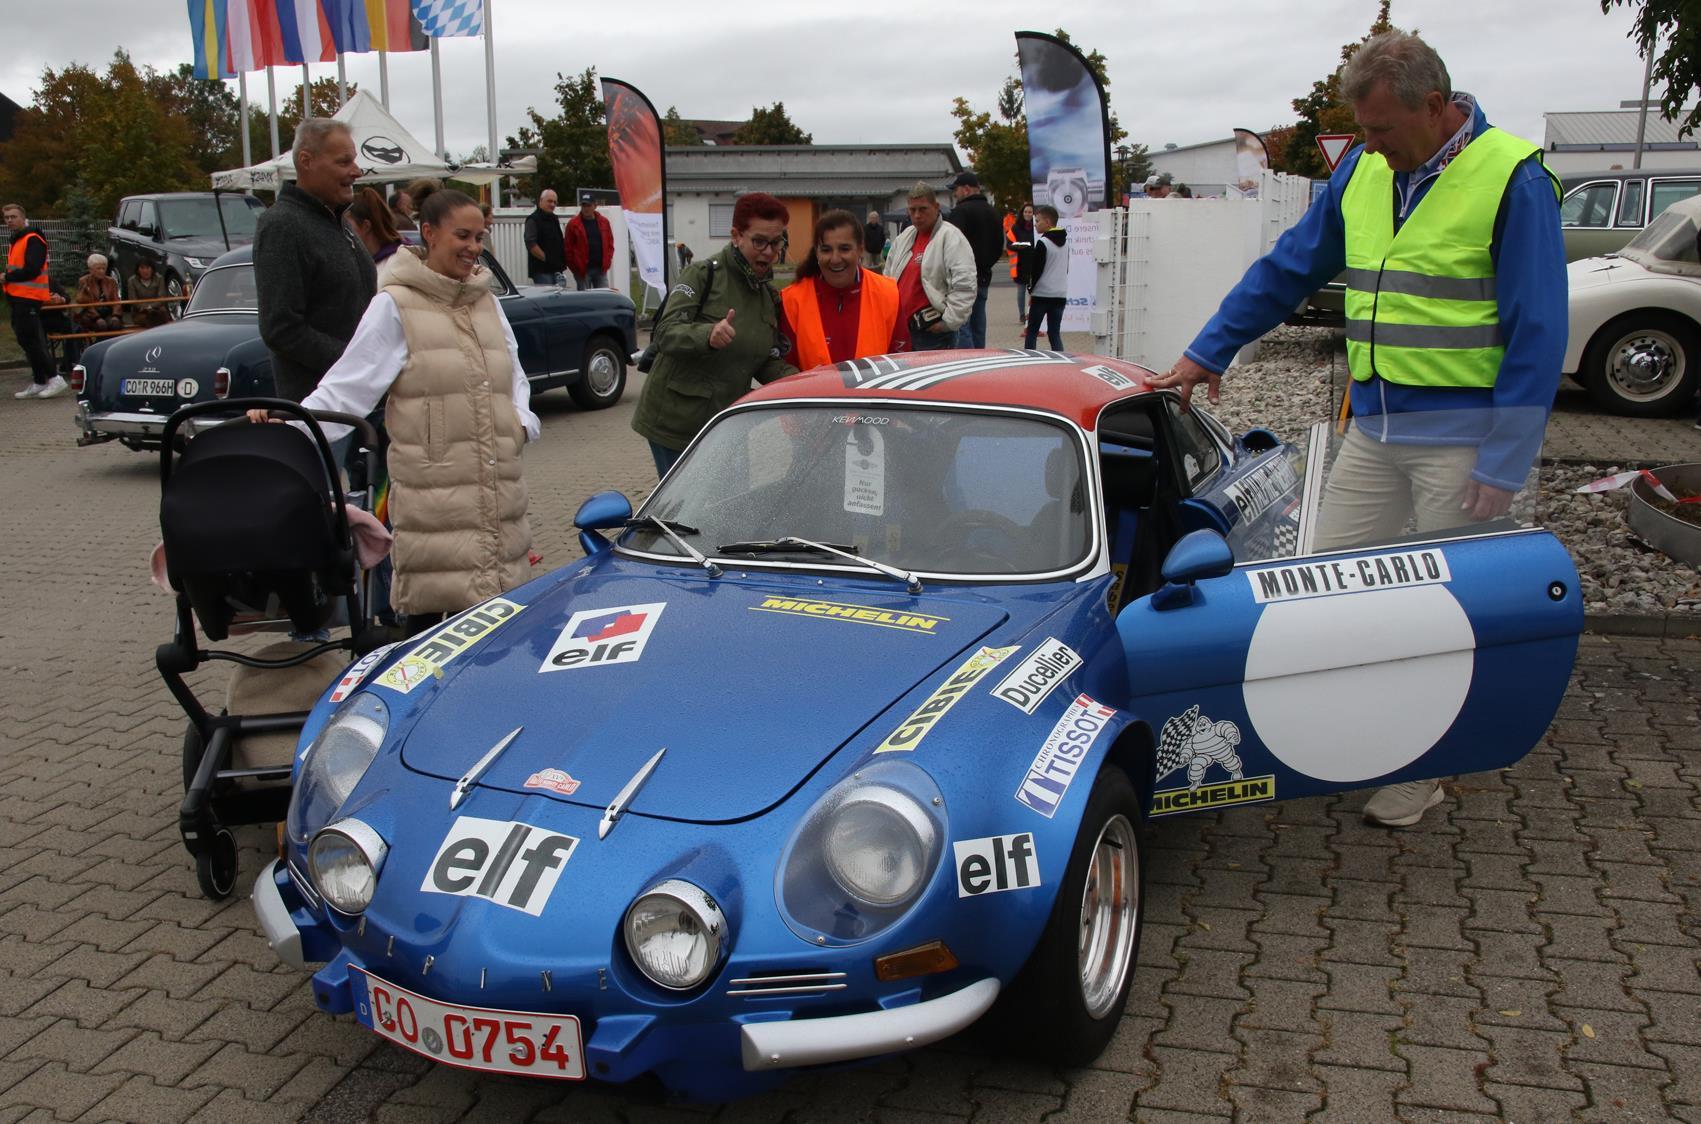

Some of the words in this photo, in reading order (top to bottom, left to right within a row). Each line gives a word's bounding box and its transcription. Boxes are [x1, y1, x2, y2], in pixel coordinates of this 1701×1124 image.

[126, 380, 137, 394] CO
[142, 381, 149, 394] R
[150, 381, 175, 395] 966H
[184, 382, 192, 395] D
[1258, 552, 1440, 599] MONTE-CARLO
[414, 603, 515, 663] CIBIE
[760, 599, 938, 630] MICHELIN
[551, 641, 637, 666] elf
[1000, 646, 1075, 708] Ducellier
[888, 667, 988, 746] CIBIE
[1035, 704, 1080, 769] CHRONOGRAPHES
[1045, 709, 1105, 776] TISSOT
[1150, 782, 1268, 810] MICHELIN
[433, 824, 575, 909] elf
[960, 834, 1032, 893] elf
[373, 986, 419, 1044] CO
[443, 1013, 569, 1070] 0754
